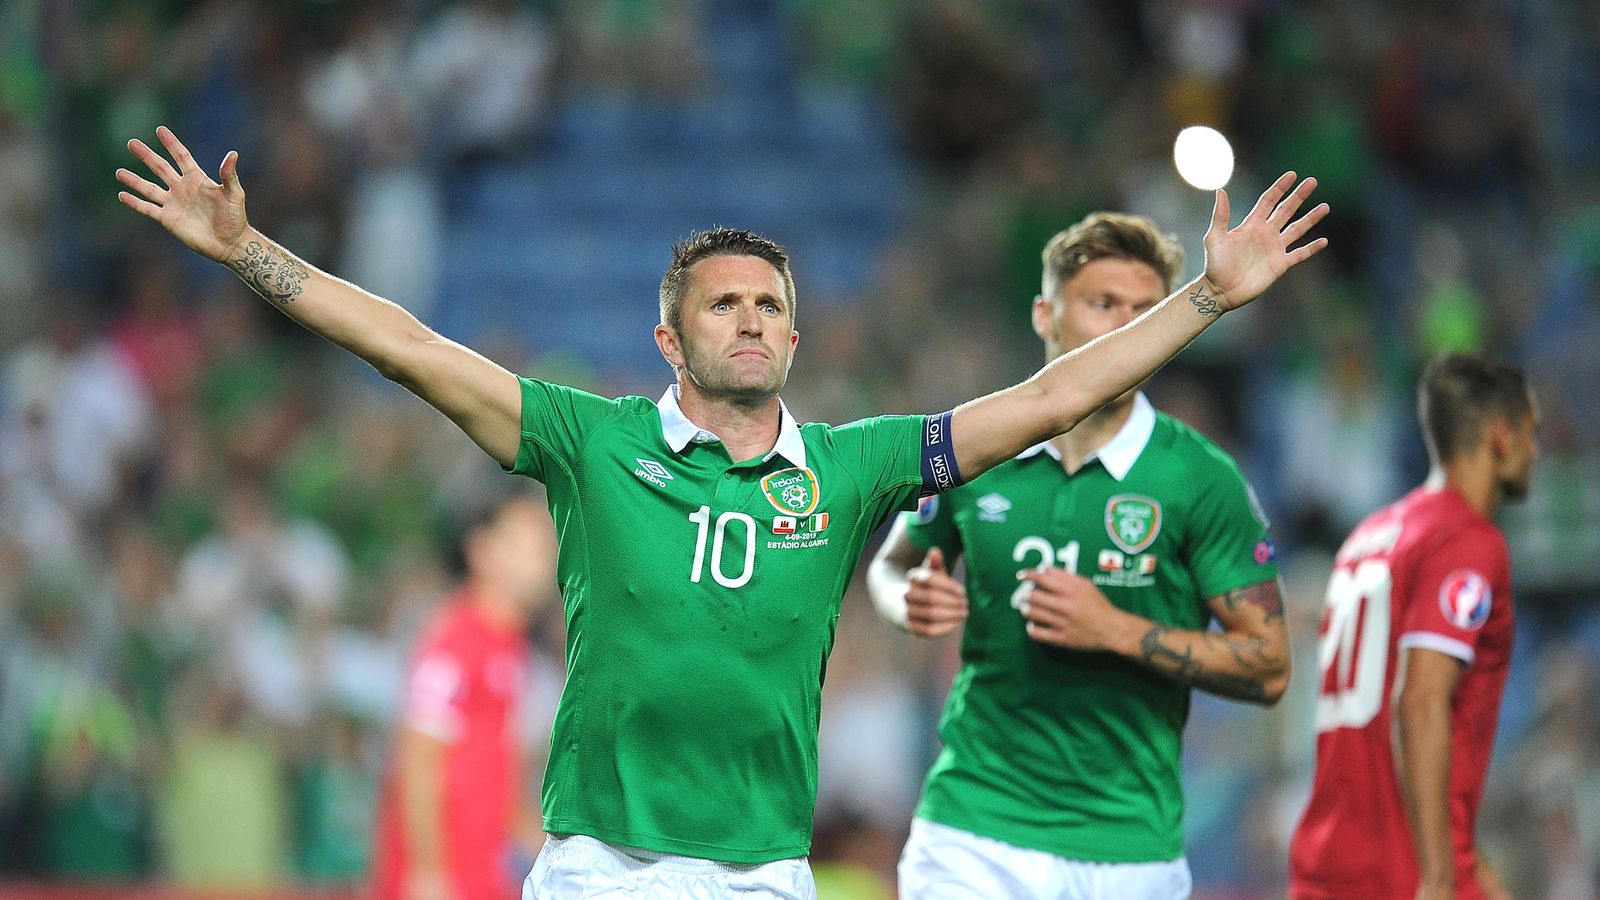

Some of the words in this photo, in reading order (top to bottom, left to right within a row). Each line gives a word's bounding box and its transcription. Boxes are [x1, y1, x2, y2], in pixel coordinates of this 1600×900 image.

[634, 468, 667, 488] umbro
[769, 473, 805, 489] Ireland
[933, 454, 951, 491] ACISM
[688, 505, 757, 588] 10
[800, 538, 829, 549] ALGARVE
[1315, 558, 1392, 733] 20
